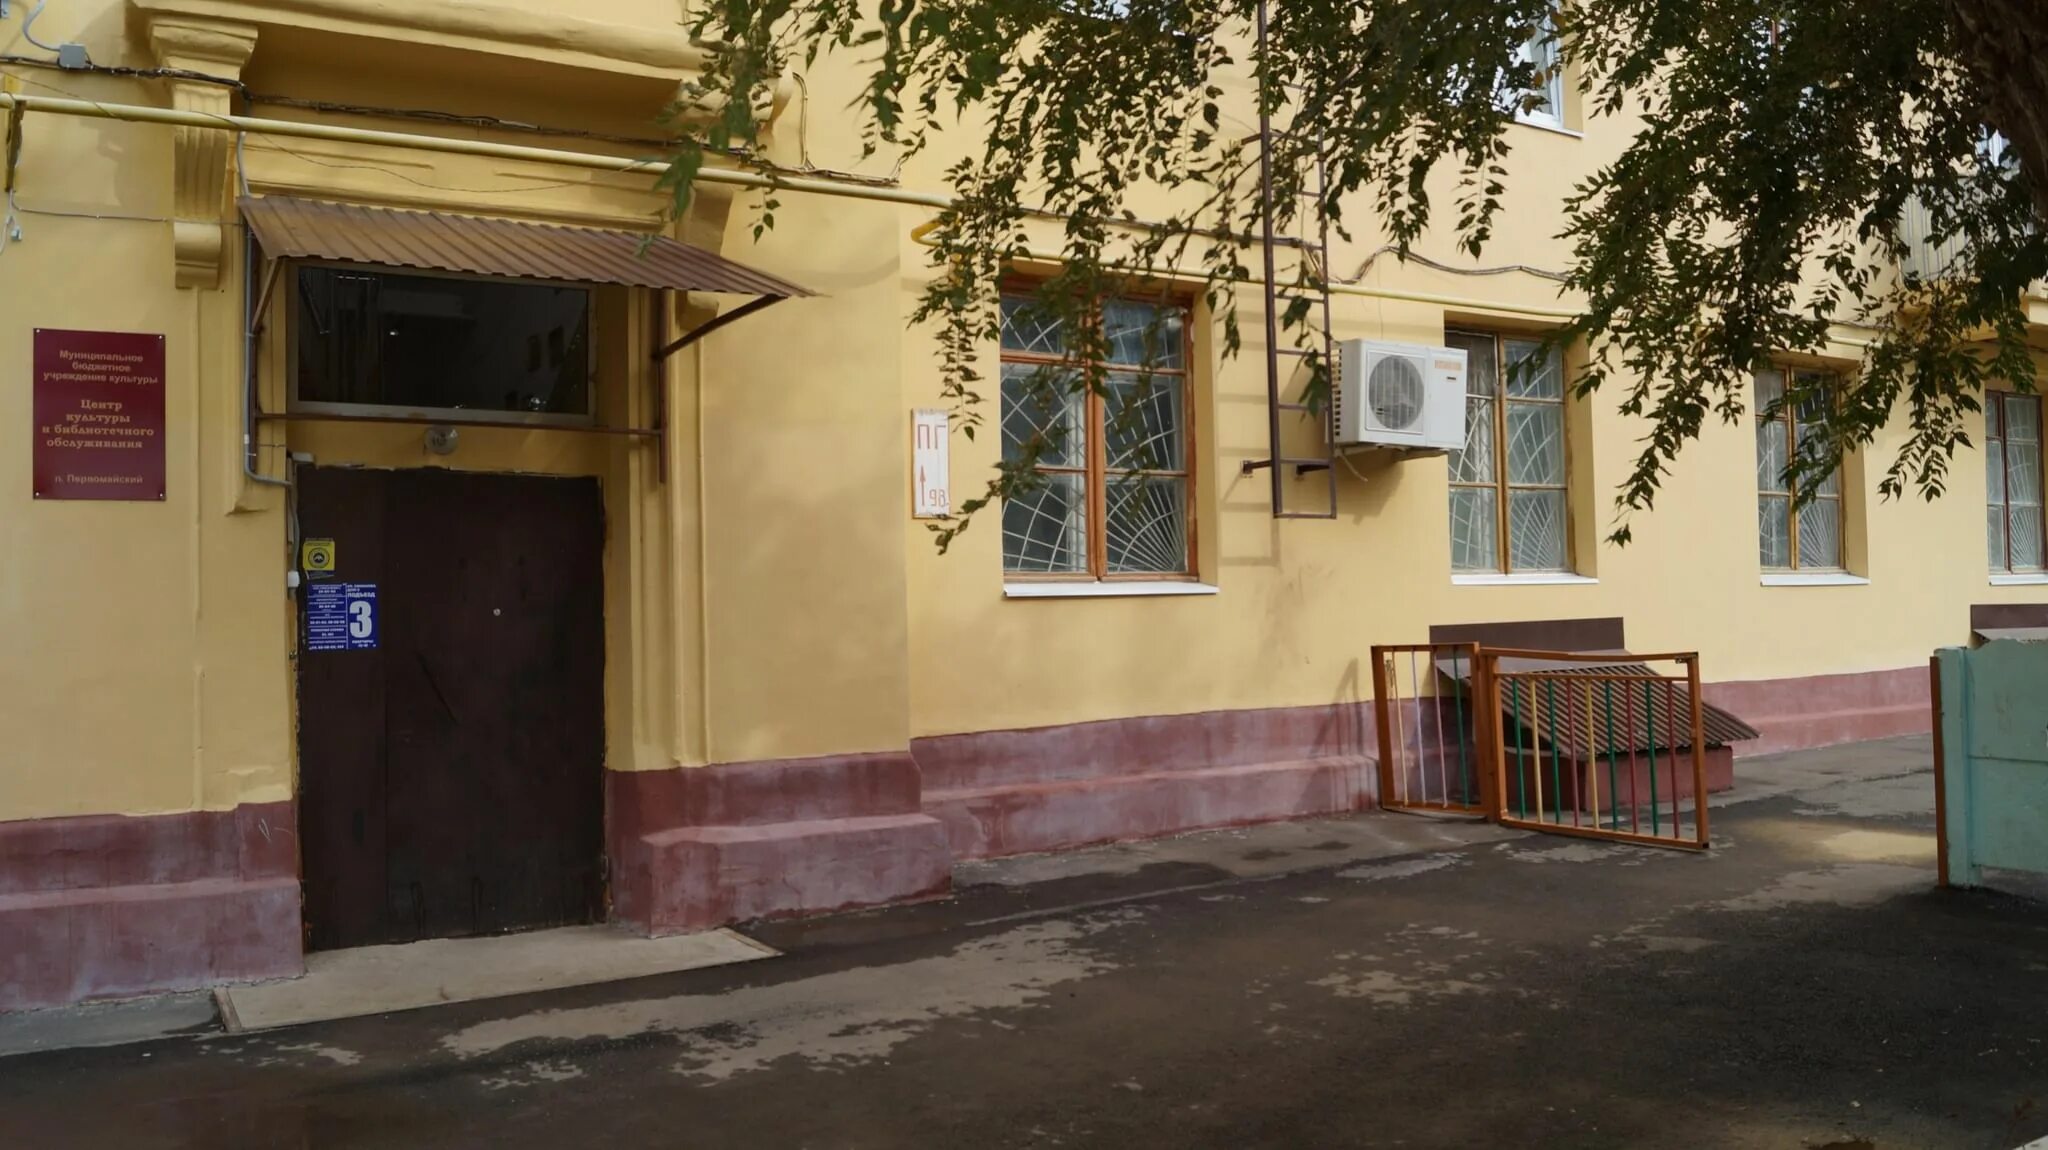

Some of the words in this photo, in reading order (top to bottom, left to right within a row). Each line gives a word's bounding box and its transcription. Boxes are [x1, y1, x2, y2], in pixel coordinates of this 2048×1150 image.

[59, 350, 144, 362] Муниципальное
[72, 361, 131, 372] бюджетное
[43, 371, 107, 382] учреждение
[109, 374, 158, 385] культуры
[81, 399, 122, 412] Центр
[66, 414, 130, 424] культуры
[42, 426, 49, 434] и
[54, 423, 154, 436] библиотечного
[917, 423, 946, 449] ПГ
[47, 437, 143, 449] обслуживания
[67, 473, 143, 484] Первомайский
[349, 600, 372, 638] 3
